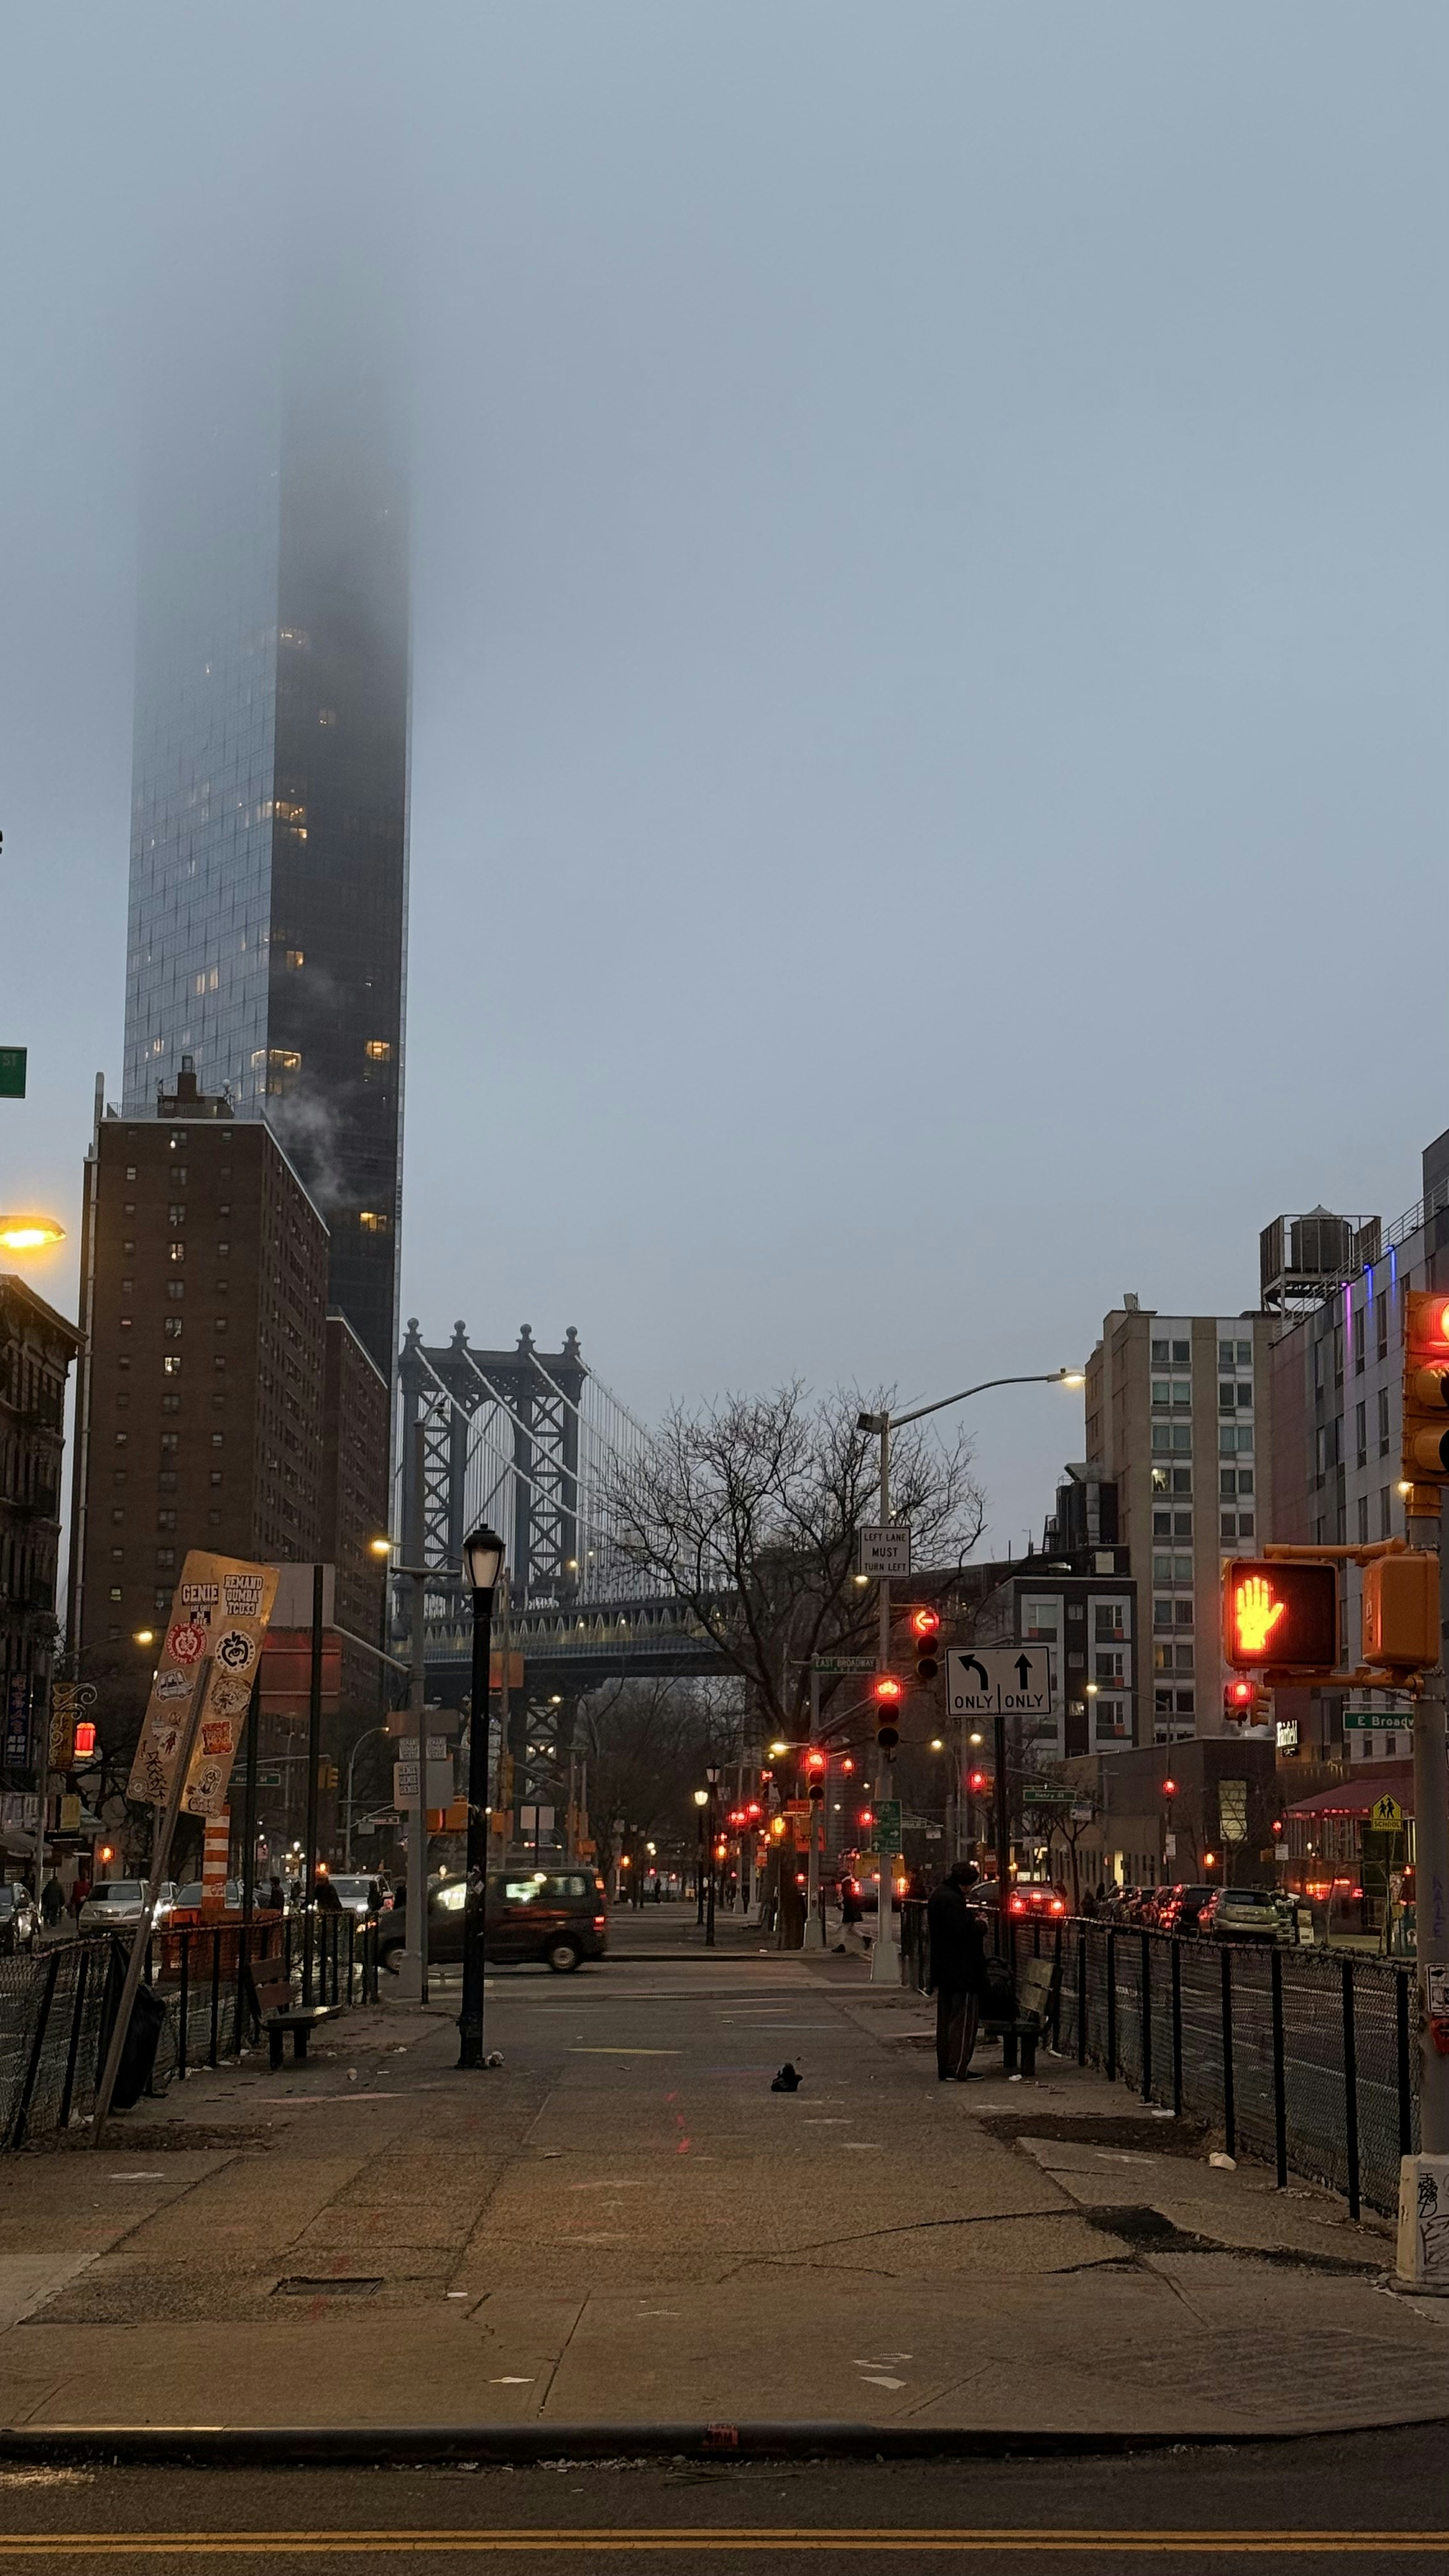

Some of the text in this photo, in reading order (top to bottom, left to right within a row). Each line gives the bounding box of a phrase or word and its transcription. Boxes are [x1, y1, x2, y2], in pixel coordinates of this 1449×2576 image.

[864, 1533, 882, 1542] LEFT
[872, 1547, 898, 1558] MUST
[864, 1563, 906, 1571] TURN LEFT
[183, 1584, 218, 1602] GENIE
[837, 1659, 875, 1667] BROADWAY
[954, 1694, 1043, 1708] ONLY ONLY
[1358, 1716, 1366, 1726] E
